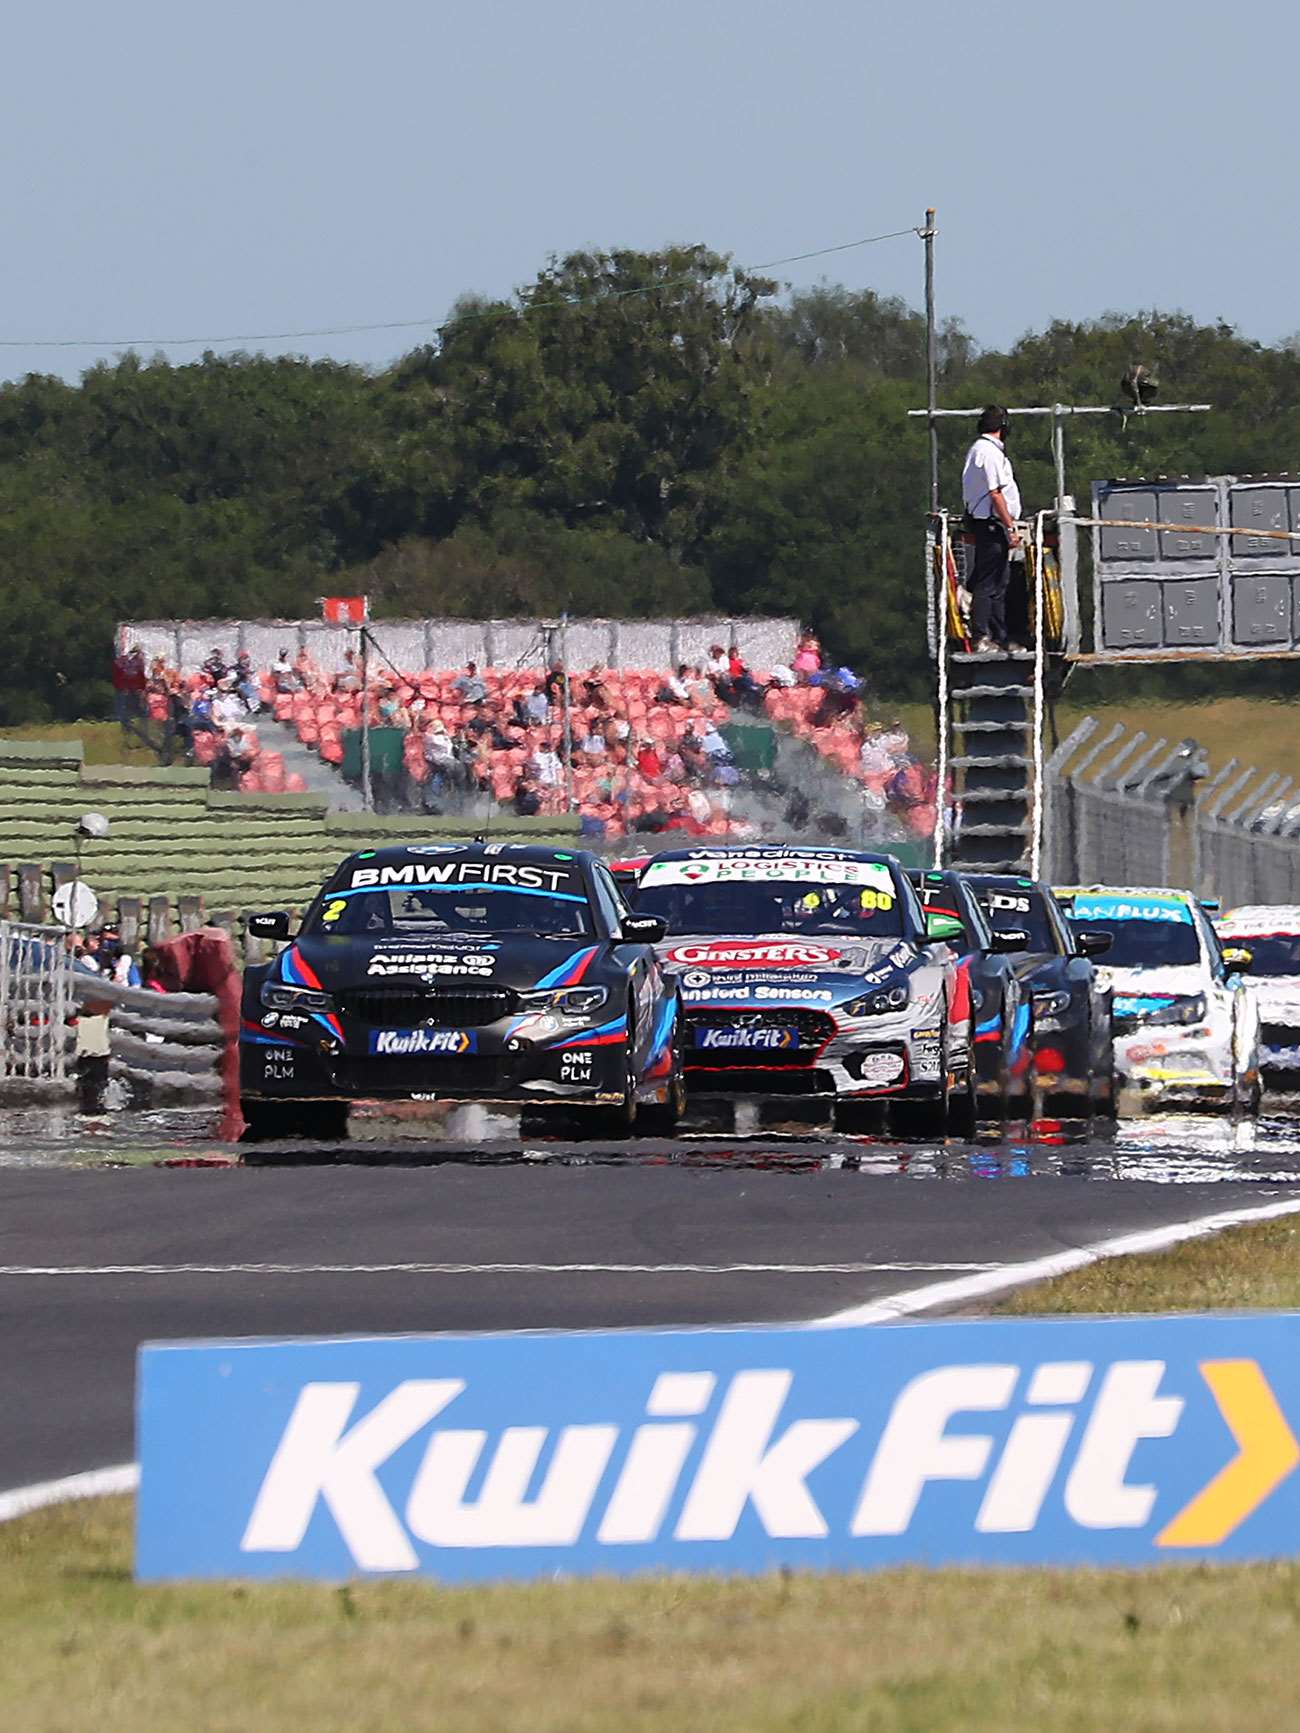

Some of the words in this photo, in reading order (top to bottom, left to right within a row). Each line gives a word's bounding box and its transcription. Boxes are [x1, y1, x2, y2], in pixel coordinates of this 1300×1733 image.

[715, 868, 860, 881] PEOPLE
[718, 860, 860, 874] LOGISTICS
[860, 887, 893, 911] 80
[321, 899, 348, 922] 2
[368, 953, 459, 964] Allianz
[673, 943, 831, 963] GINSTERS
[366, 963, 494, 978] Assistance
[754, 986, 833, 1001] Sensors
[265, 1049, 294, 1061] ONE
[562, 1052, 593, 1065] ONE
[264, 1064, 294, 1079] PLM
[560, 1066, 592, 1081] PLM
